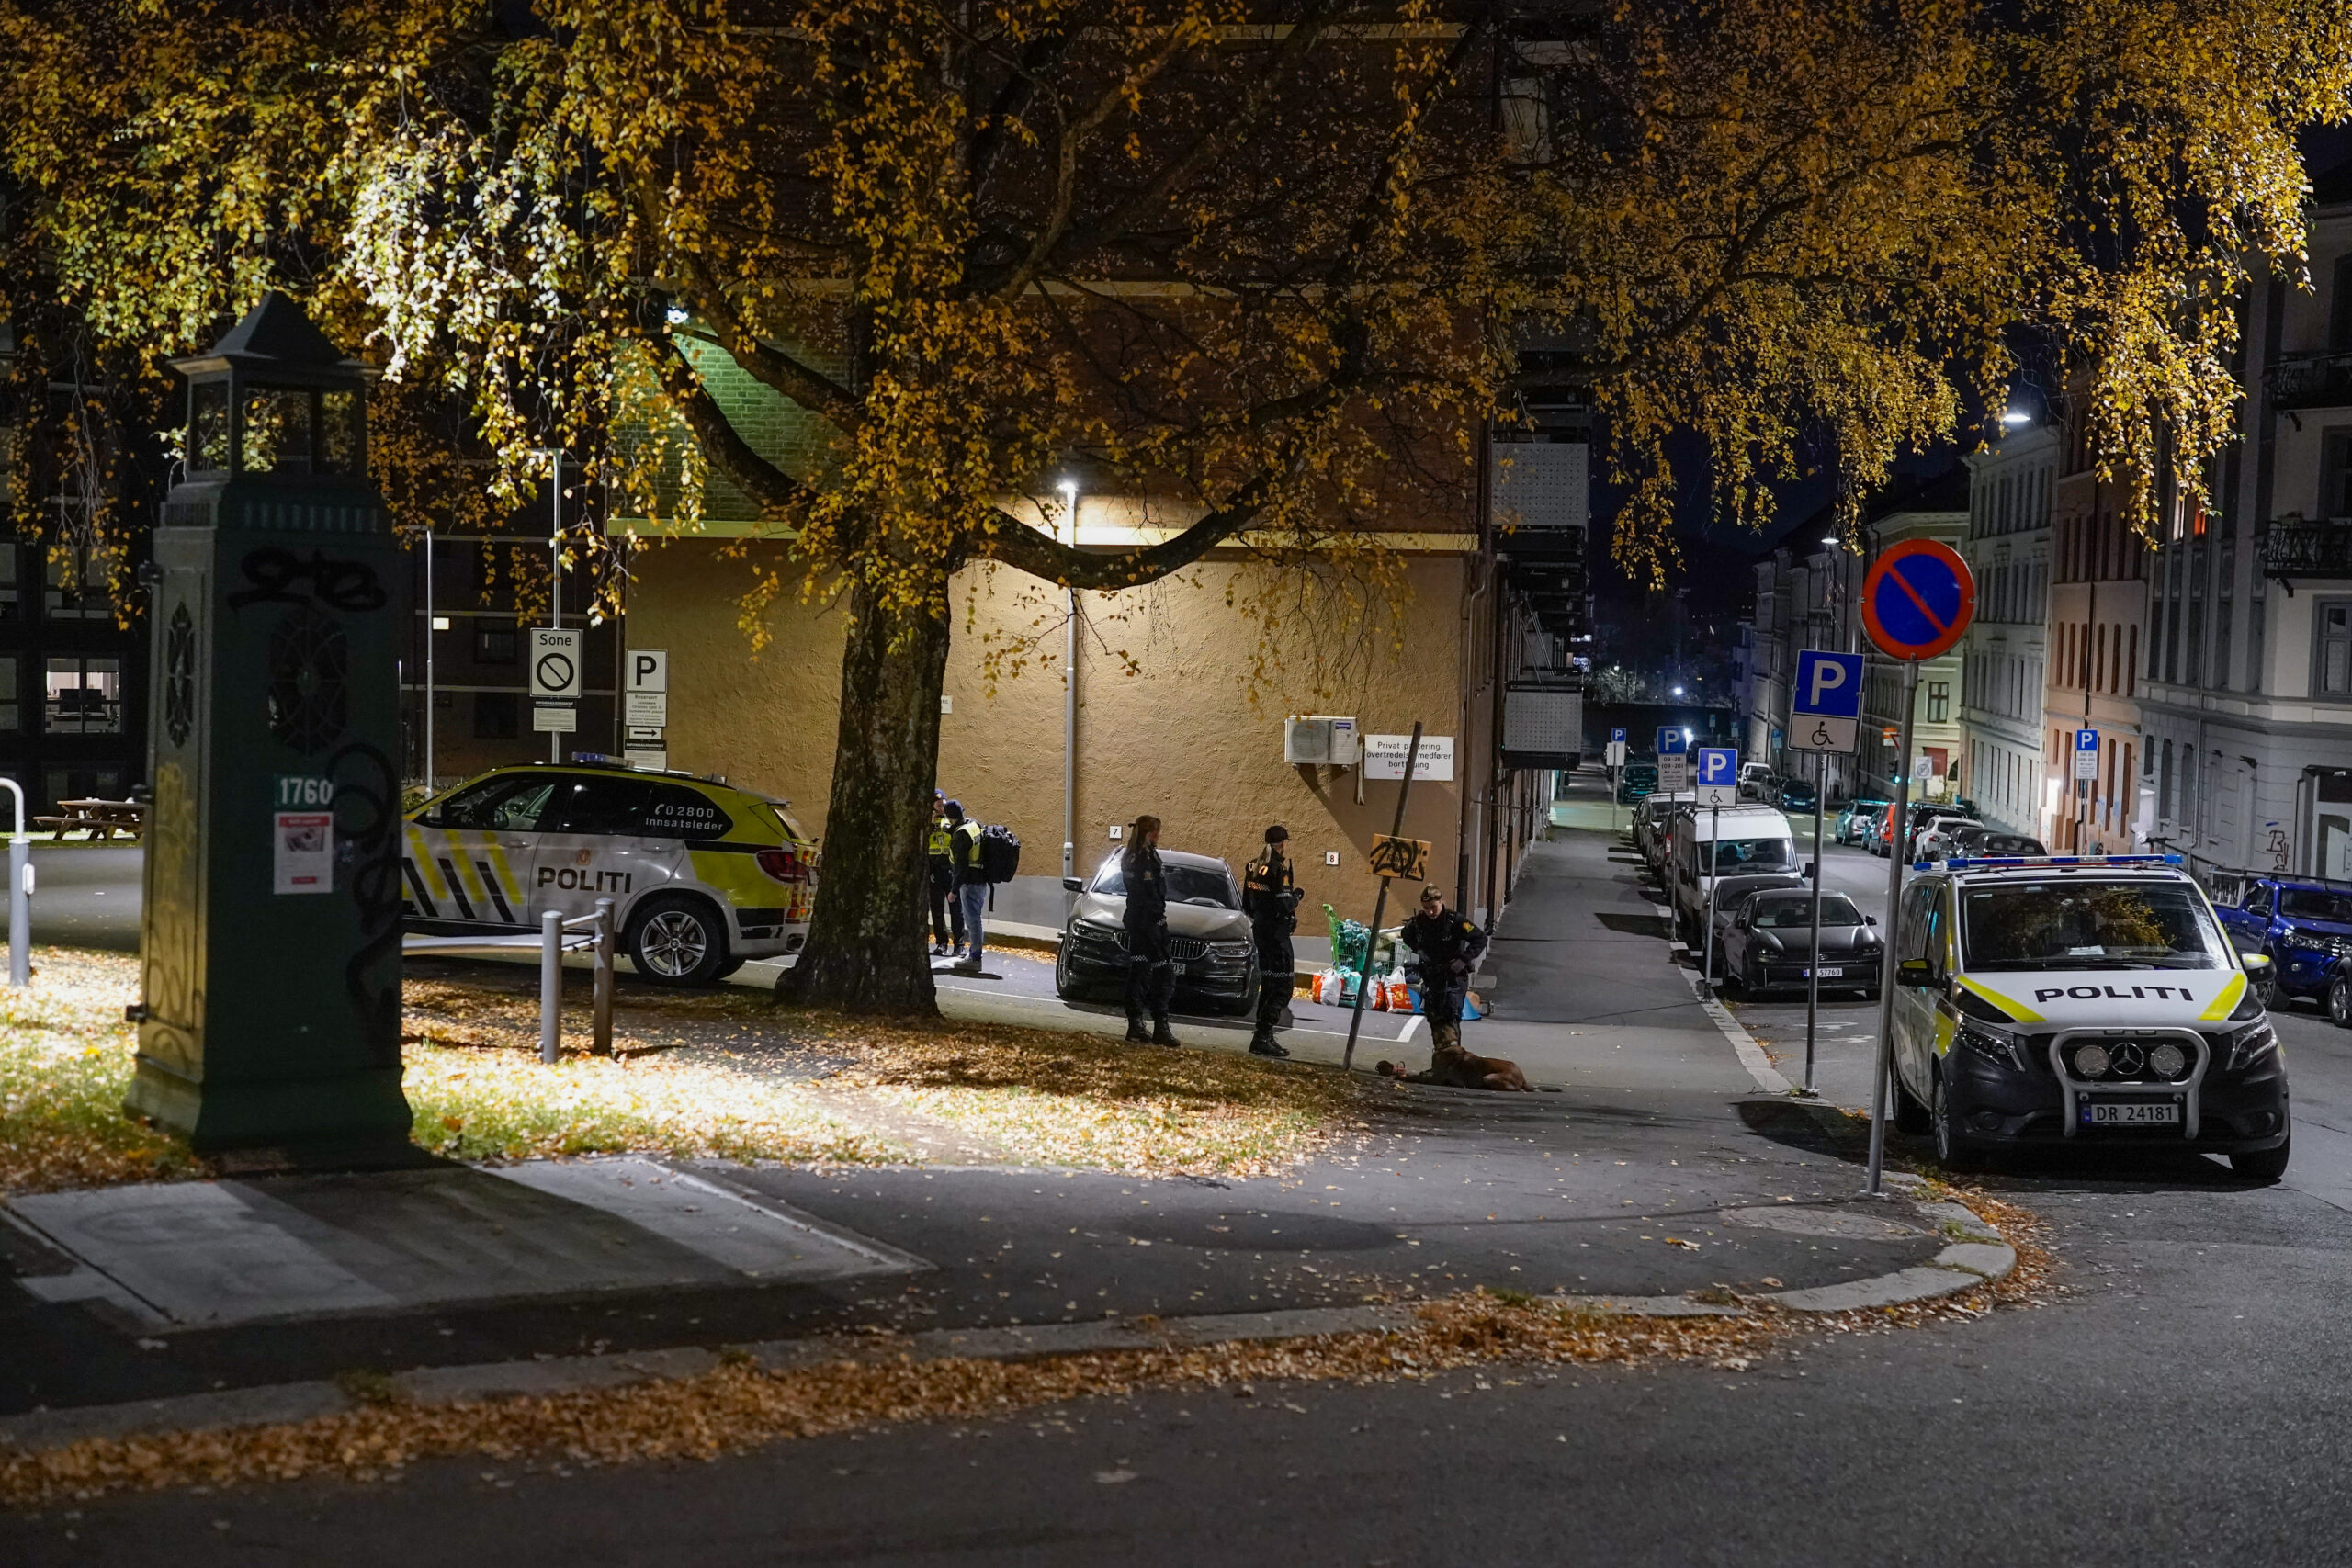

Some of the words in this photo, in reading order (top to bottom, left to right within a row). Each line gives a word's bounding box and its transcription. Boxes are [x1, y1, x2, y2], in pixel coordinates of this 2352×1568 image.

[539, 634, 571, 646] Sone
[636, 655, 657, 686] P
[1810, 660, 1846, 705] P
[1615, 729, 1623, 739] P
[1665, 730, 1679, 751] P
[2081, 732, 2093, 749] P
[1707, 753, 1727, 781] P
[280, 777, 333, 805] 1760
[537, 866, 632, 894] POLITI
[2034, 985, 2194, 1003] POLITI
[2097, 1106, 2119, 1121] DR
[2127, 1106, 2173, 1121] 24181
